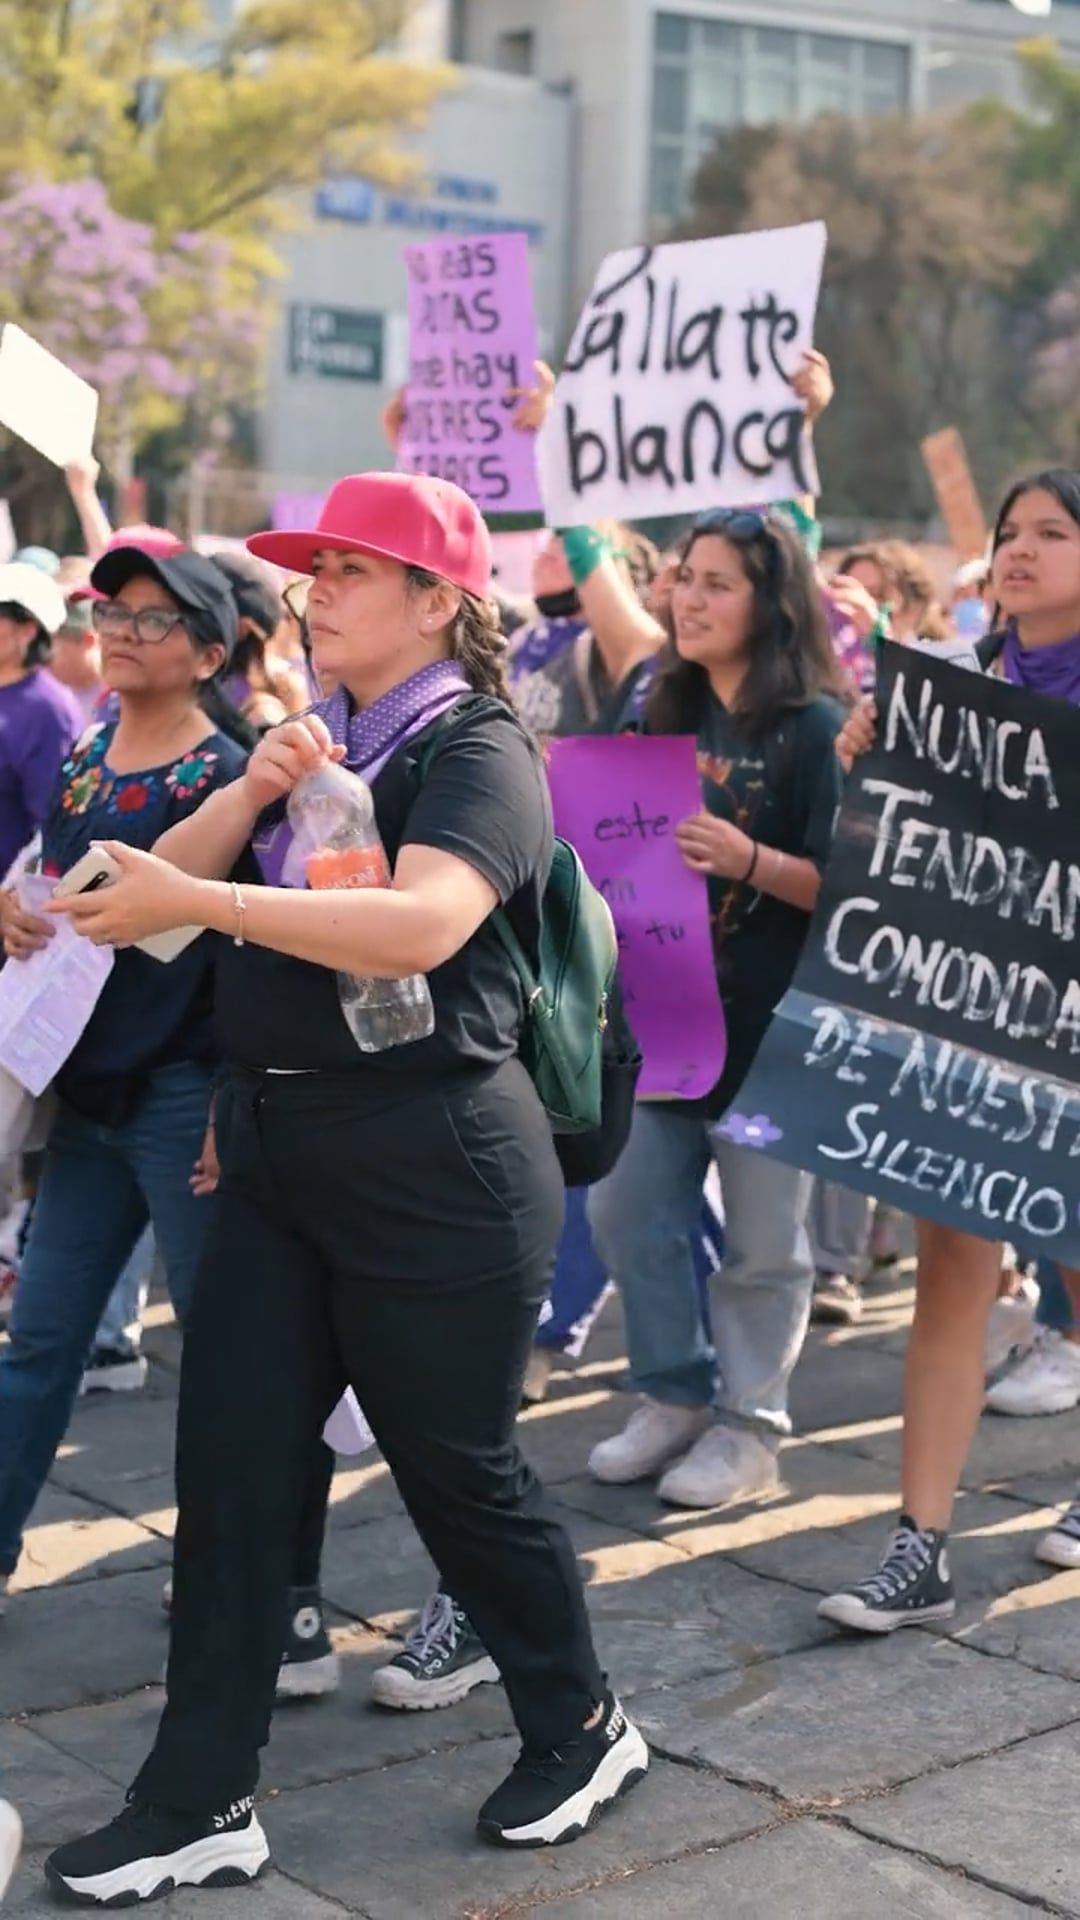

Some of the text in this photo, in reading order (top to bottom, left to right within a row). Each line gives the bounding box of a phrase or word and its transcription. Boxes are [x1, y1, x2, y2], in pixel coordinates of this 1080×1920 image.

[451, 349, 519, 409] hay
[564, 395, 810, 494] blanca
[884, 671, 1060, 809] NUNCA
[593, 802, 670, 842] este
[804, 1005, 1080, 1157] DE NUEST
[817, 1102, 1067, 1237] SILENCIO
